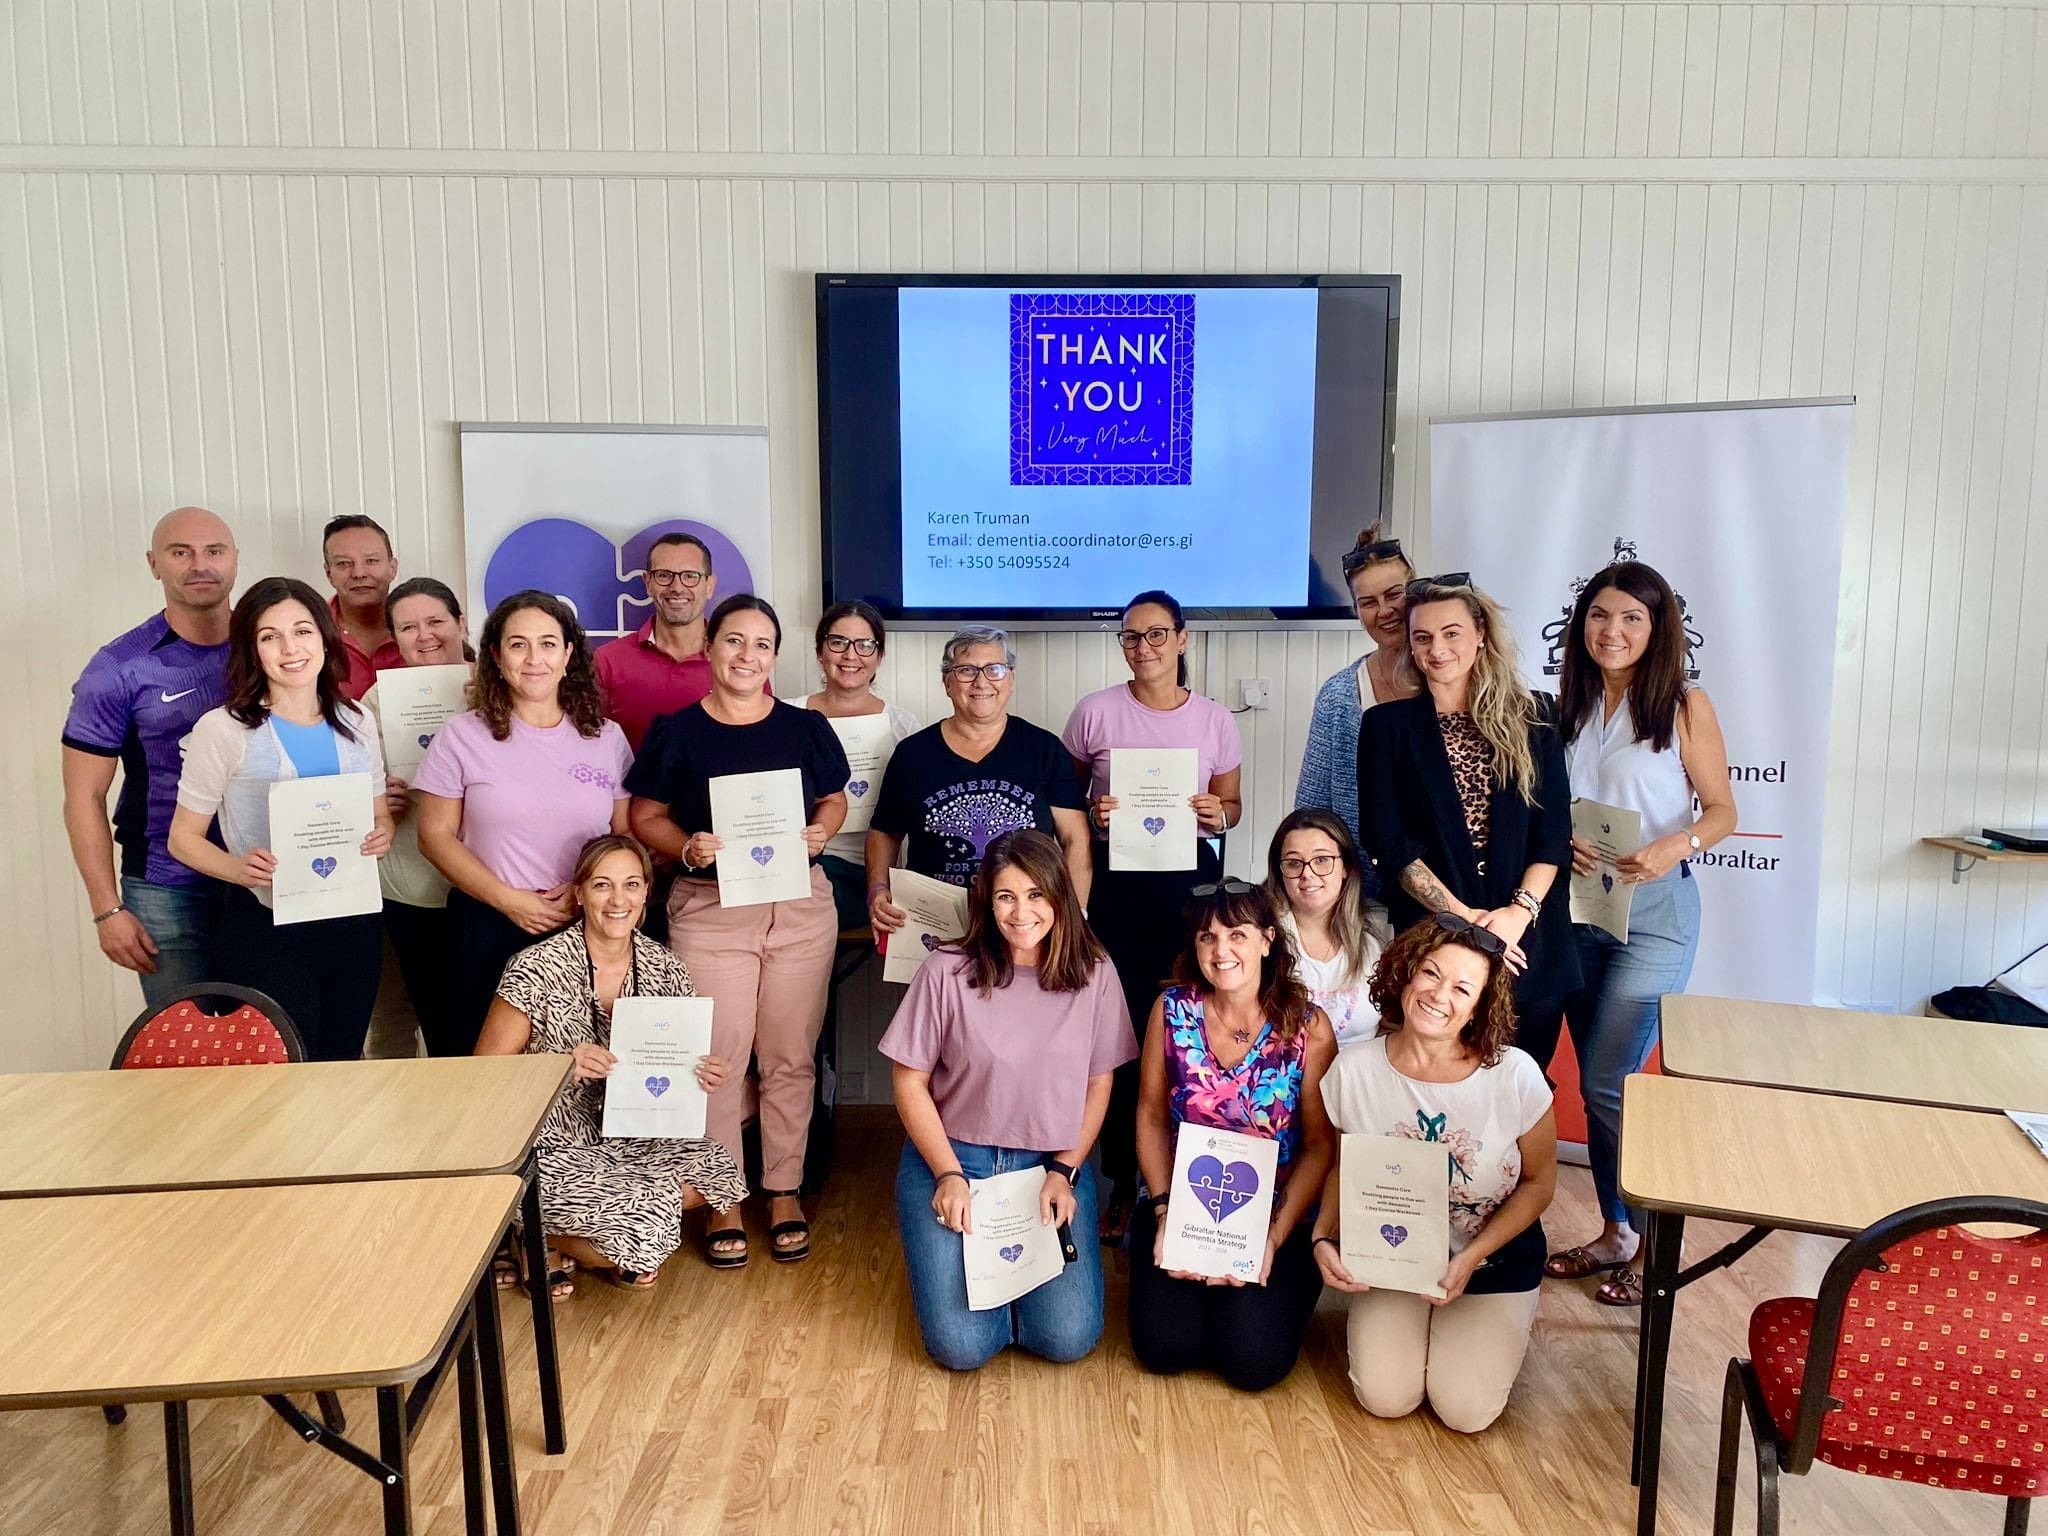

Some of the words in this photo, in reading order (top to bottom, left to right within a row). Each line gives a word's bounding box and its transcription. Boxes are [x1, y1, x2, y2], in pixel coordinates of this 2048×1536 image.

[1035, 333, 1168, 365] THANK
[1060, 380, 1143, 412] YOU
[1047, 421, 1090, 454] Very
[1095, 423, 1154, 452] Much
[927, 511, 969, 525] Karen
[974, 511, 1030, 525] Truman
[927, 533, 972, 547] Email:
[977, 532, 1193, 550] dementia.coordinator@ers.gi
[927, 555, 952, 569] Tel:
[957, 555, 993, 569] +350
[998, 555, 1071, 569] 54095524
[1728, 760, 1786, 783] nnel
[923, 779, 1035, 807] REMEMBER
[945, 862, 970, 872] FOR
[1686, 849, 1780, 871] braltar
[1362, 1191, 1382, 1199] Enabling
[1396, 1208, 1420, 1216] Workbook
[1181, 1231, 1215, 1243] Dementia
[1218, 1238, 1247, 1250] Strategy
[1184, 1223, 1215, 1236] Gibraltar
[1217, 1229, 1247, 1241] National
[1232, 1260, 1249, 1269] GHA
